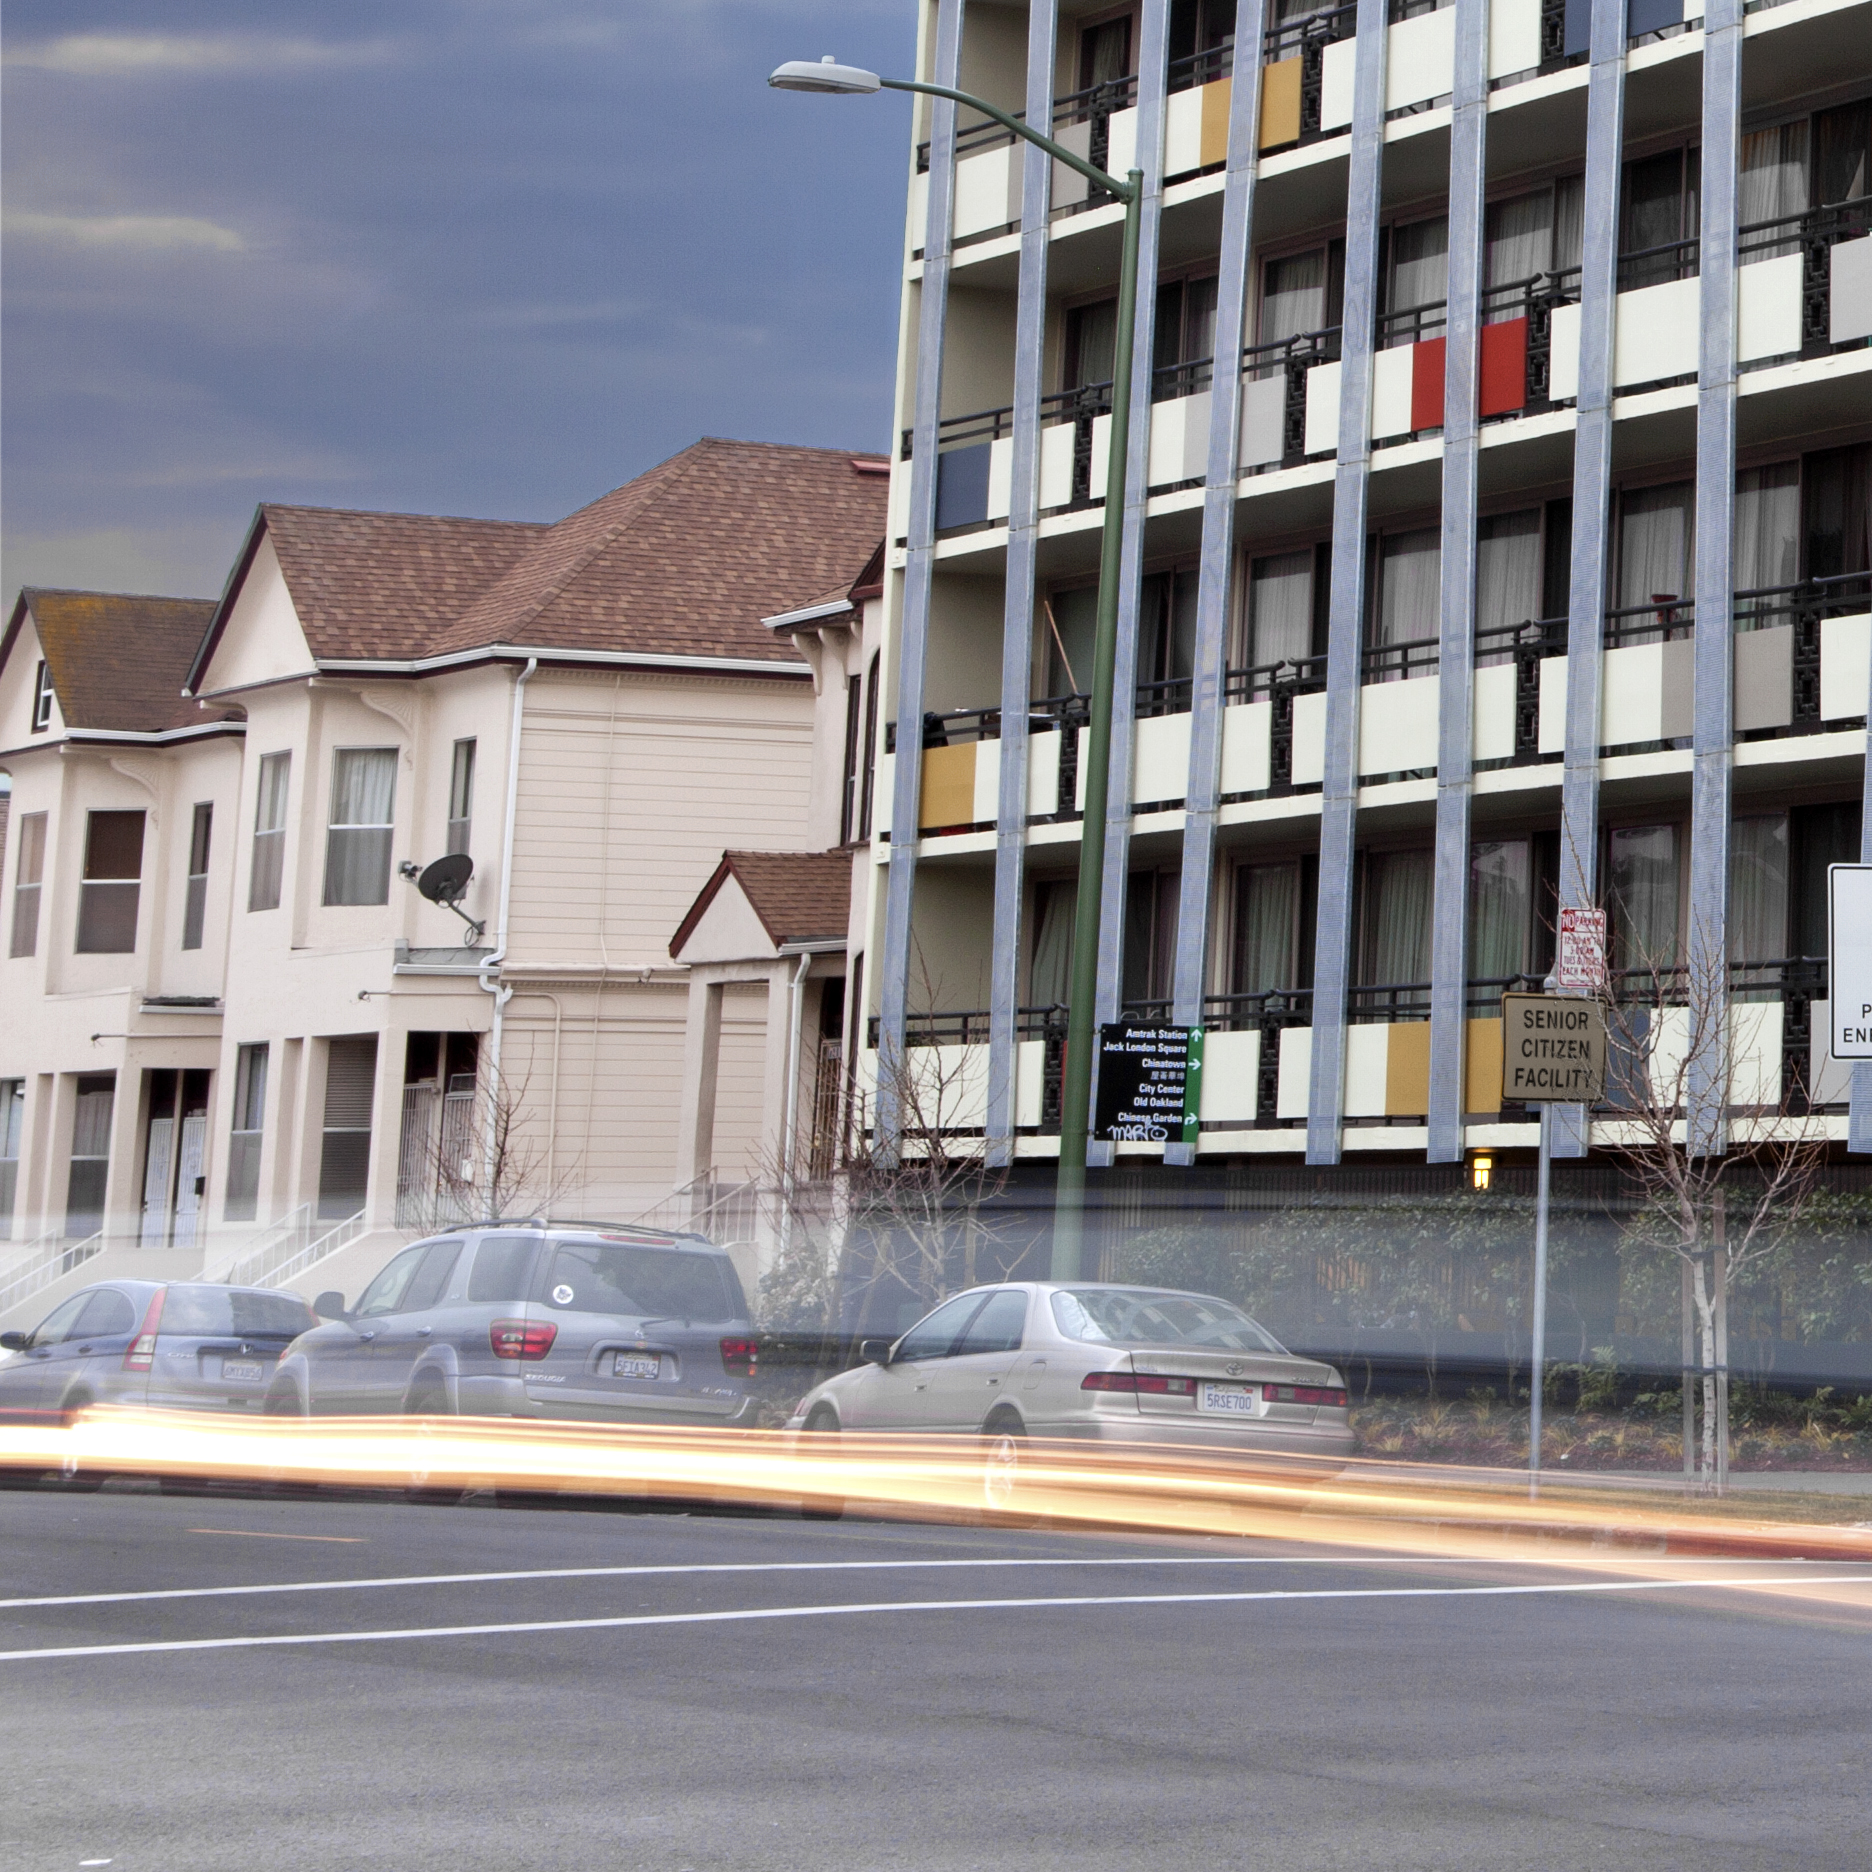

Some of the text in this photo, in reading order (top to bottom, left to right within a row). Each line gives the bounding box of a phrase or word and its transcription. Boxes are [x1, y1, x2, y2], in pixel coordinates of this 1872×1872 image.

[1563, 914, 1575, 928] NO
[1523, 1010, 1588, 1030] SENIOR
[1126, 1028, 1188, 1040] Amtrak Station
[1103, 1041, 1187, 1055] Jack London Square
[1521, 1038, 1590, 1059] CITIZEN
[1142, 1058, 1186, 1069] Chinatown
[1514, 1067, 1593, 1088] FACILITY
[1139, 1083, 1185, 1095] City Center
[1133, 1097, 1184, 1107] Old Oakland
[1118, 1112, 1183, 1123] Chinese Garden
[1207, 1393, 1252, 1410] 5RSE700
